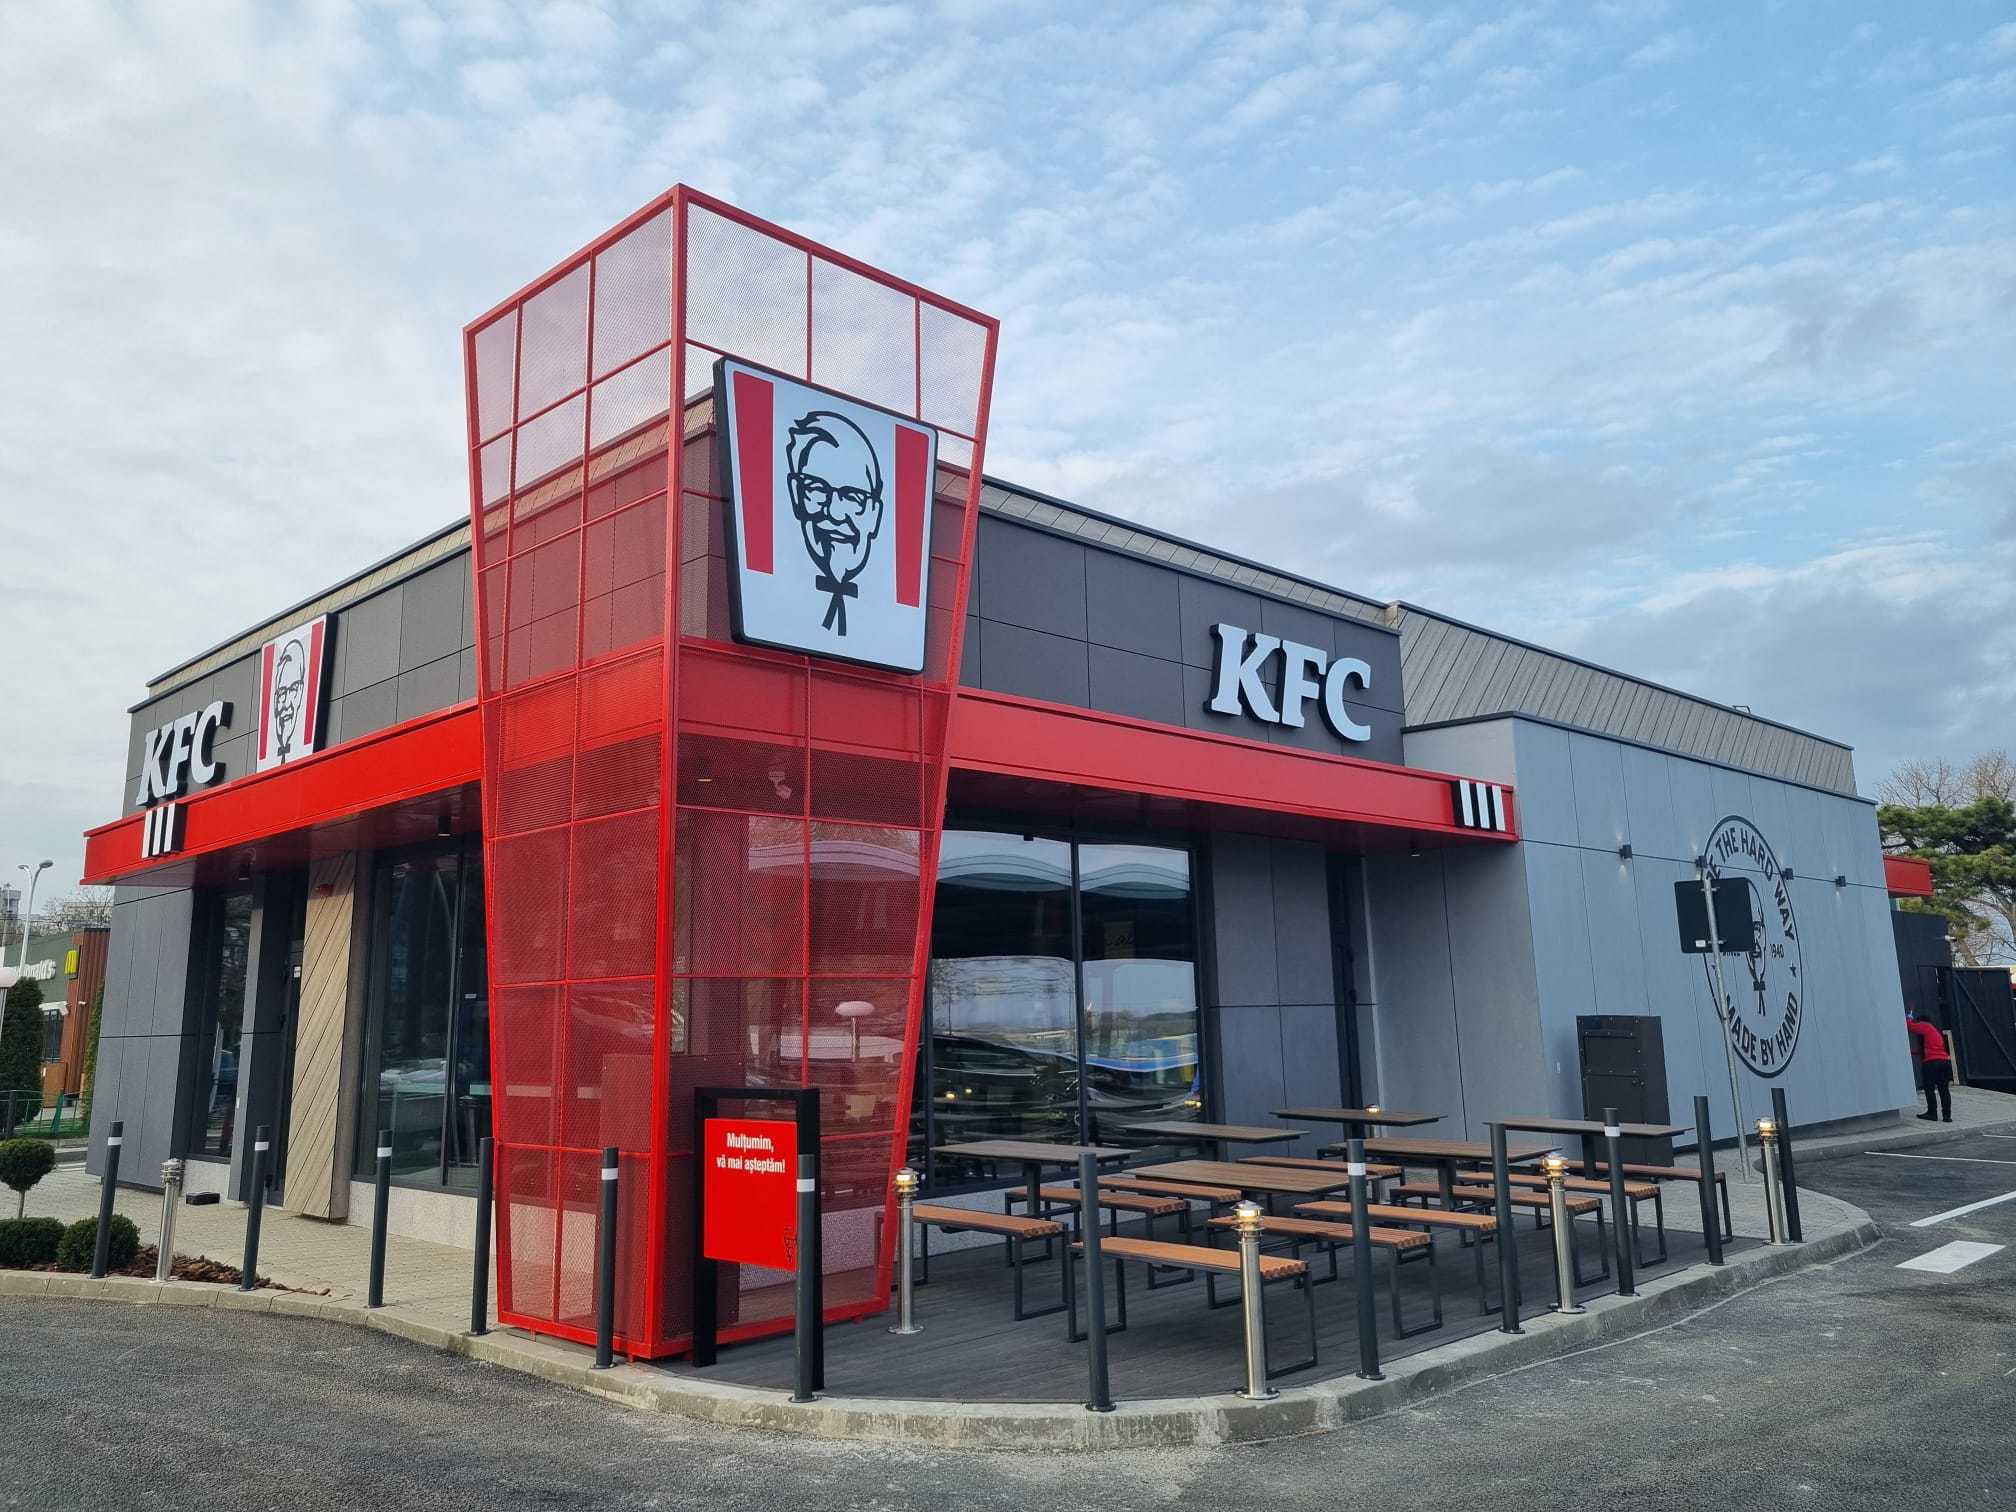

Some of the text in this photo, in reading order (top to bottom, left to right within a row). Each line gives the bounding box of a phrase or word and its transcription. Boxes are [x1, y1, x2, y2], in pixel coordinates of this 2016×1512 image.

[1210, 622, 1372, 742] KFC
[135, 700, 224, 806] KFC
[1715, 827, 1796, 941] THE HARD WAY
[1726, 991, 1799, 1066] MADE BY HAND
[727, 1155, 743, 1170] mai
